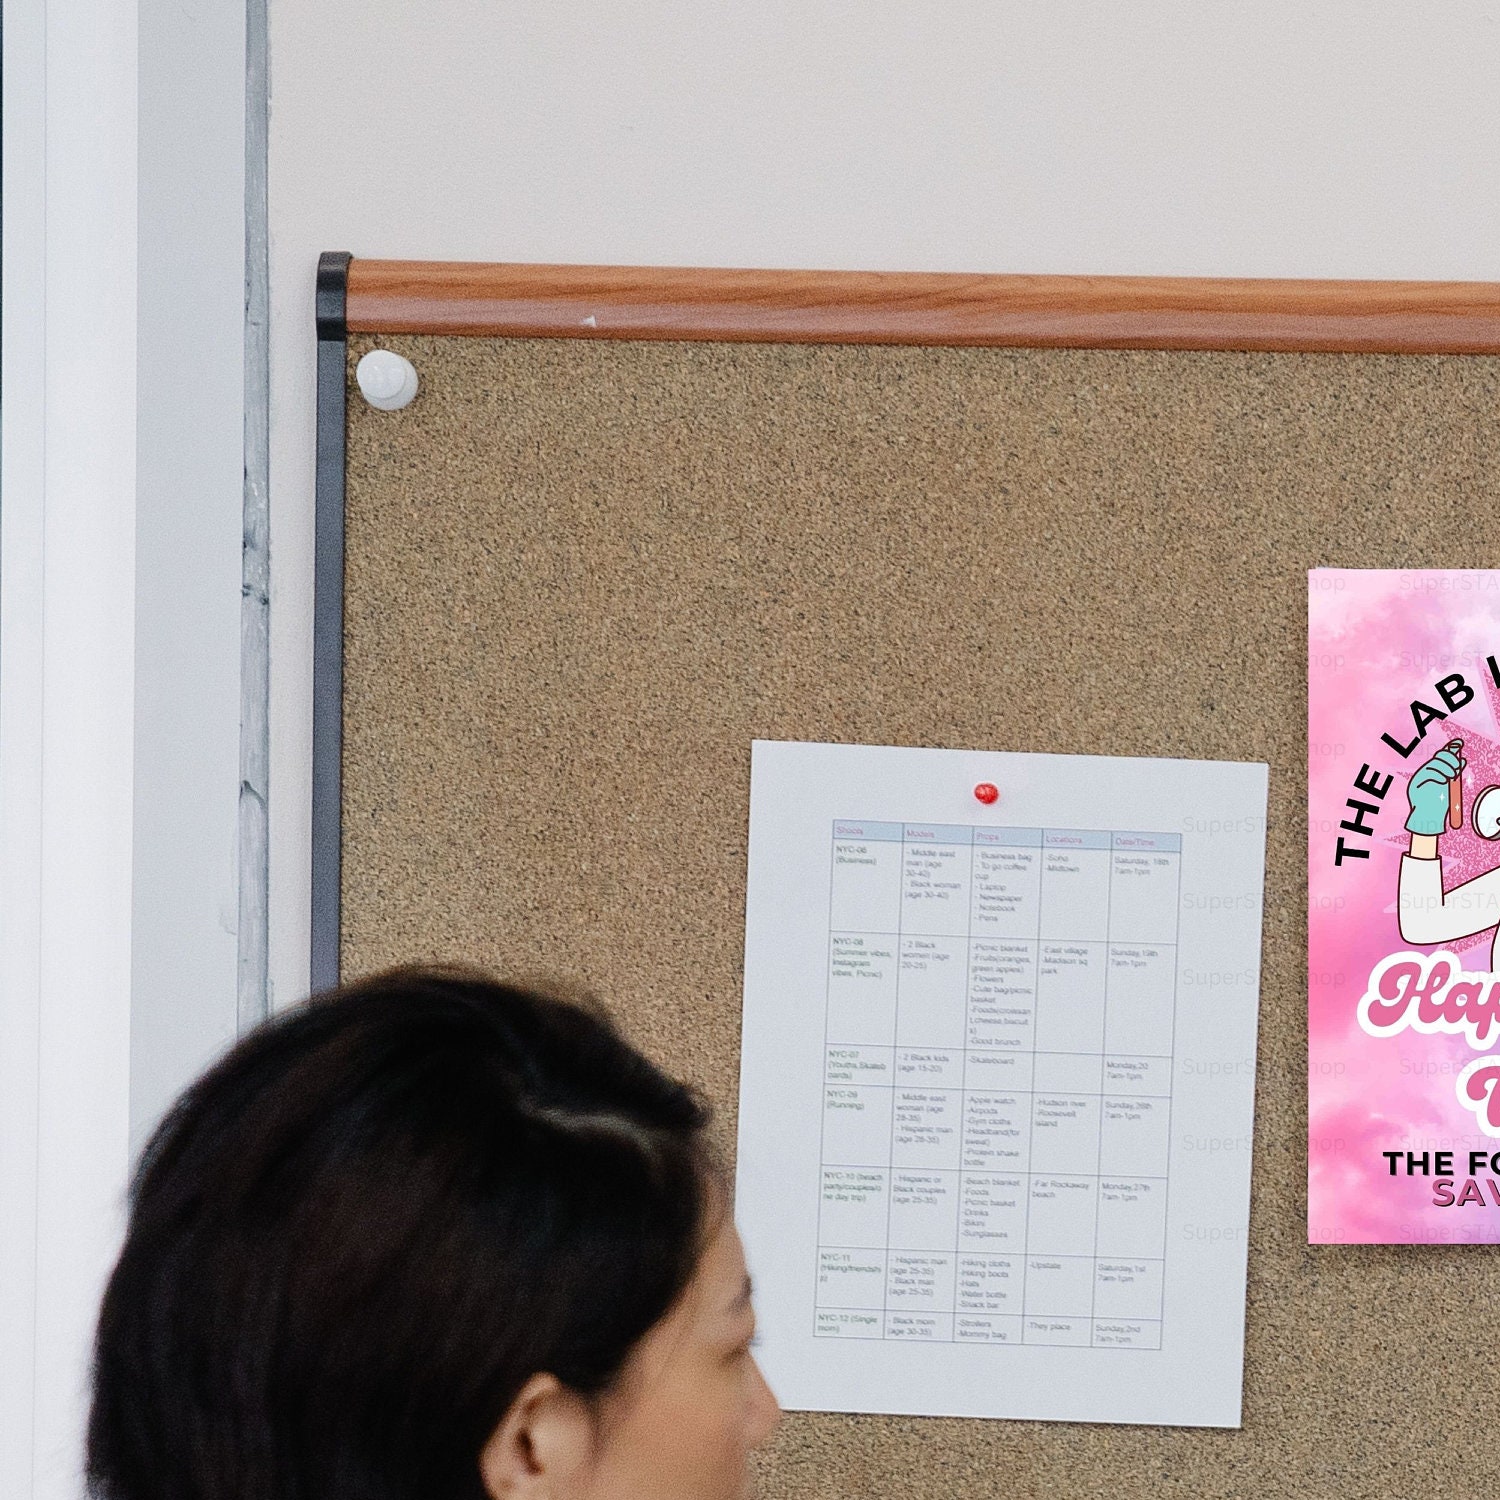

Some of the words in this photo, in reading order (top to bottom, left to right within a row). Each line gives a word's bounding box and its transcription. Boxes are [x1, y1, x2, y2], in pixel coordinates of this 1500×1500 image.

[1334, 763, 1394, 867] THE
[1380, 672, 1475, 759] LAB
[1383, 1151, 1454, 1177] THE
